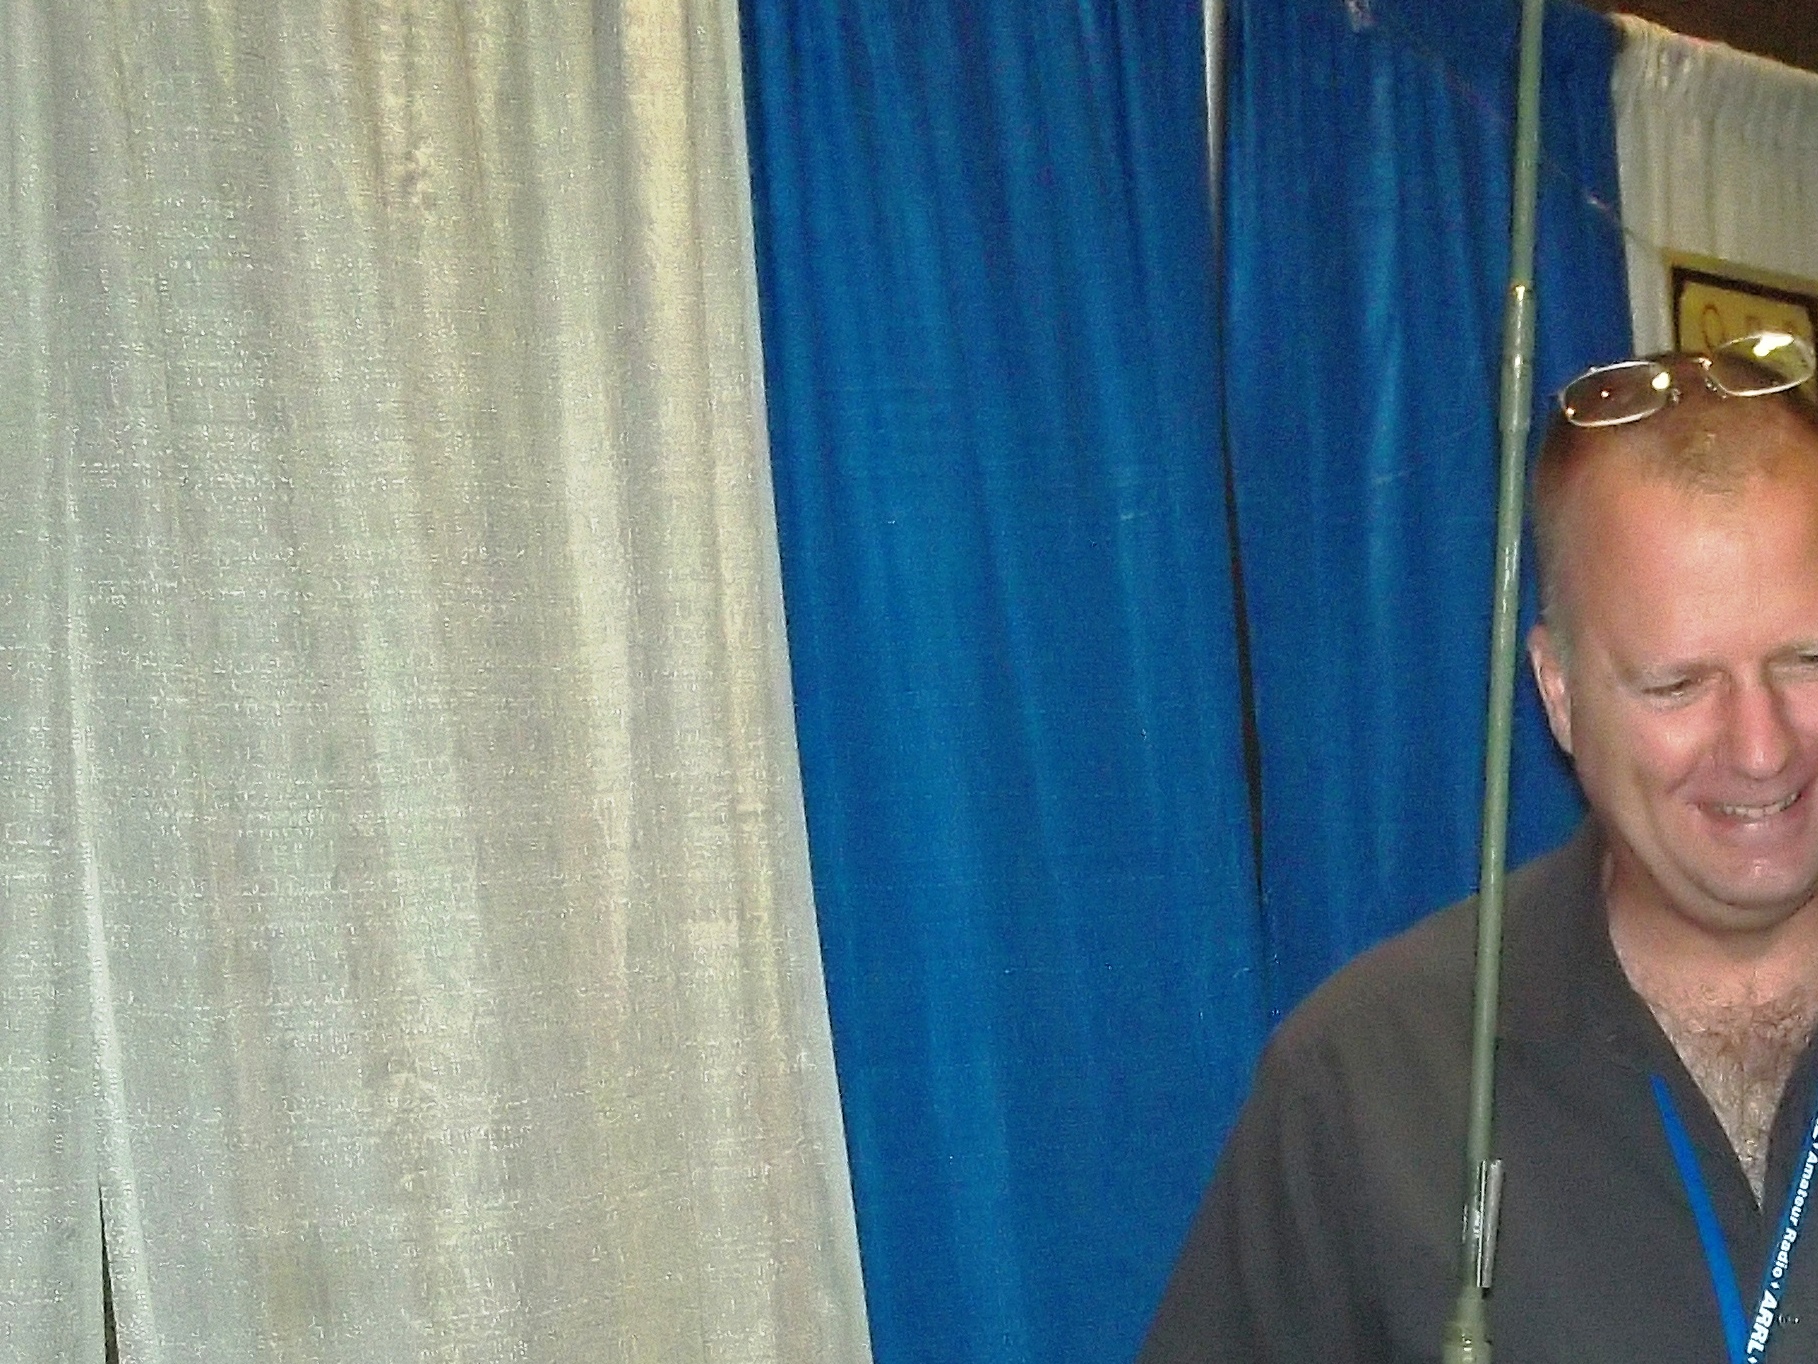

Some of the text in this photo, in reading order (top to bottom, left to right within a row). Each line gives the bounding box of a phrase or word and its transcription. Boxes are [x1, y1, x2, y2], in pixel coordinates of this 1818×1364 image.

[1789, 1149, 1818, 1227] Amateur
[1772, 1227, 1798, 1280] Radio
[1745, 1289, 1777, 1355] ARRL
